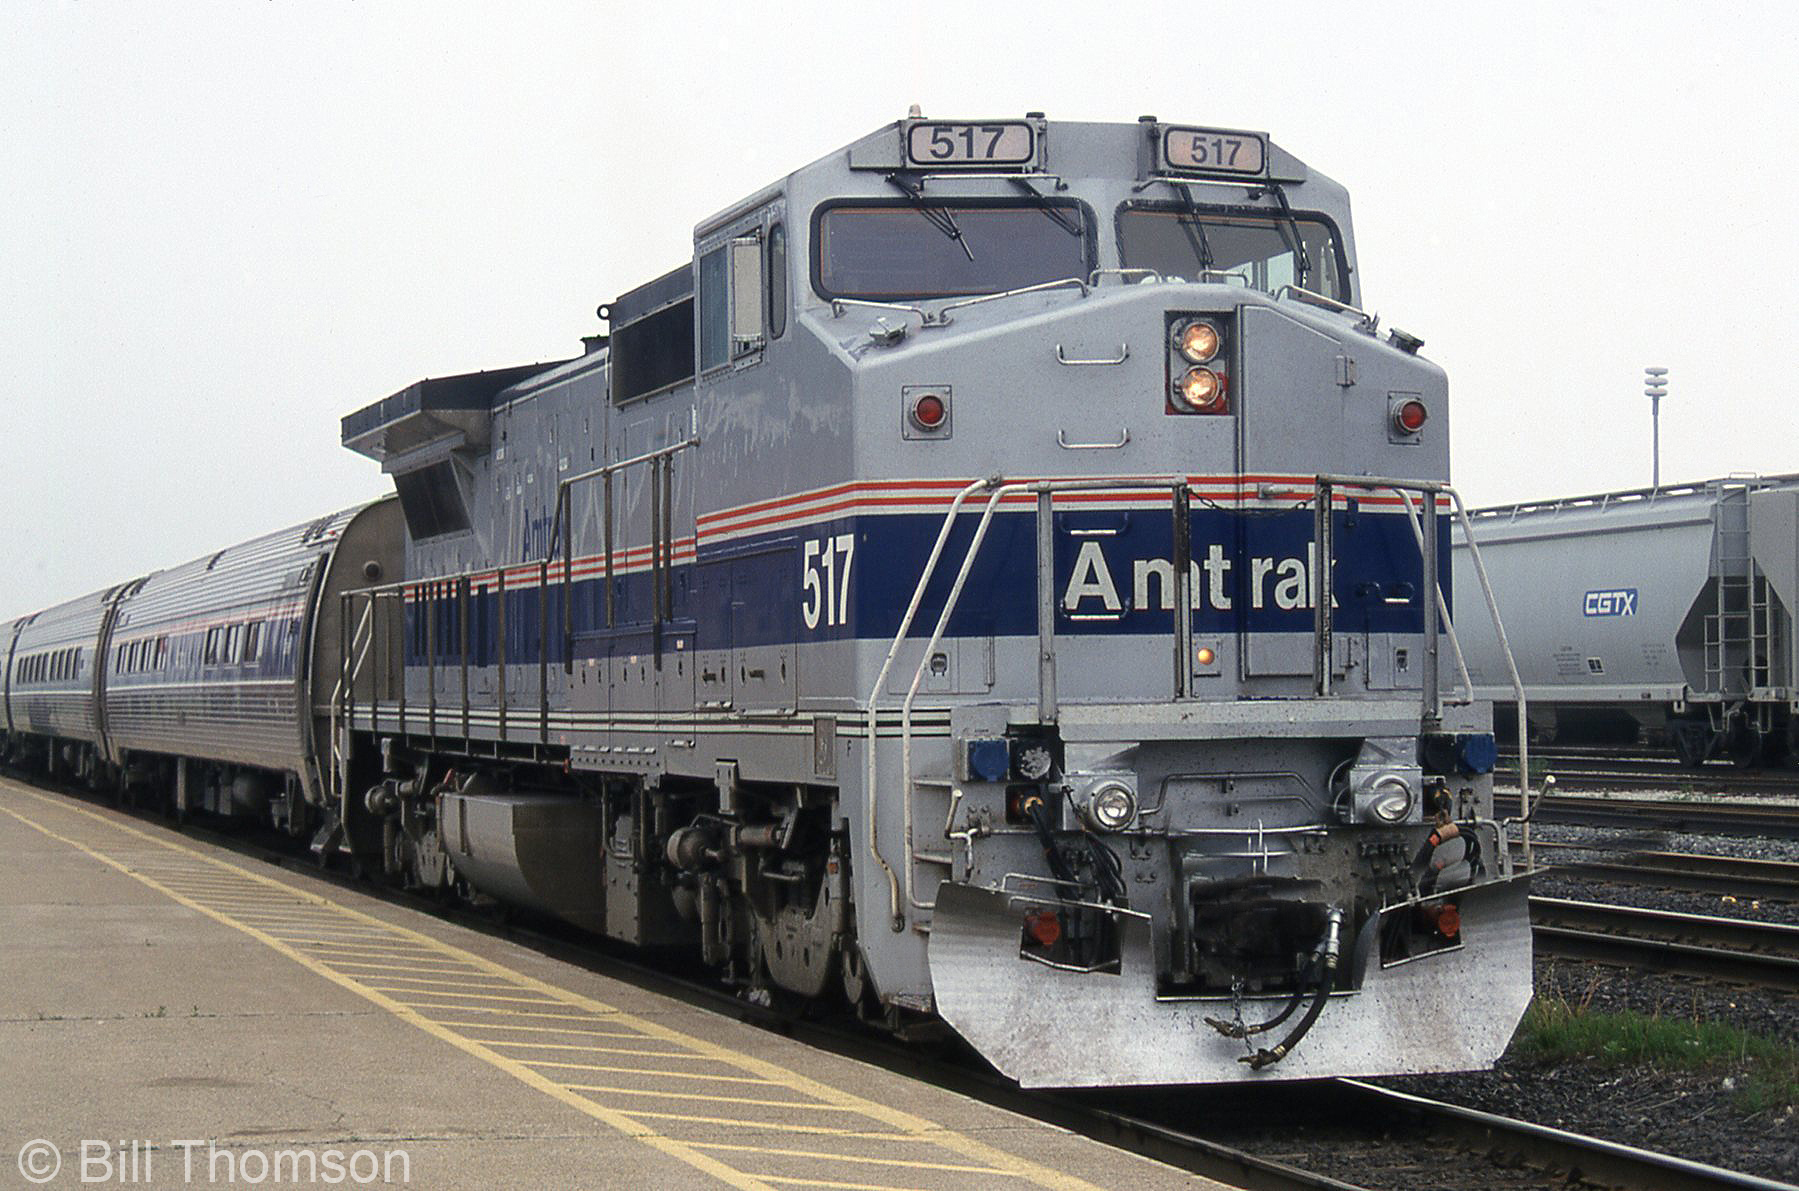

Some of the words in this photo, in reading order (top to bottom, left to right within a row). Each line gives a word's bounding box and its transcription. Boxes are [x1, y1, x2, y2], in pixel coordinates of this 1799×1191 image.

[929, 126, 1005, 159] 517
[1190, 136, 1242, 166] 517
[802, 533, 855, 629] 517
[1584, 591, 1635, 616] CGTX
